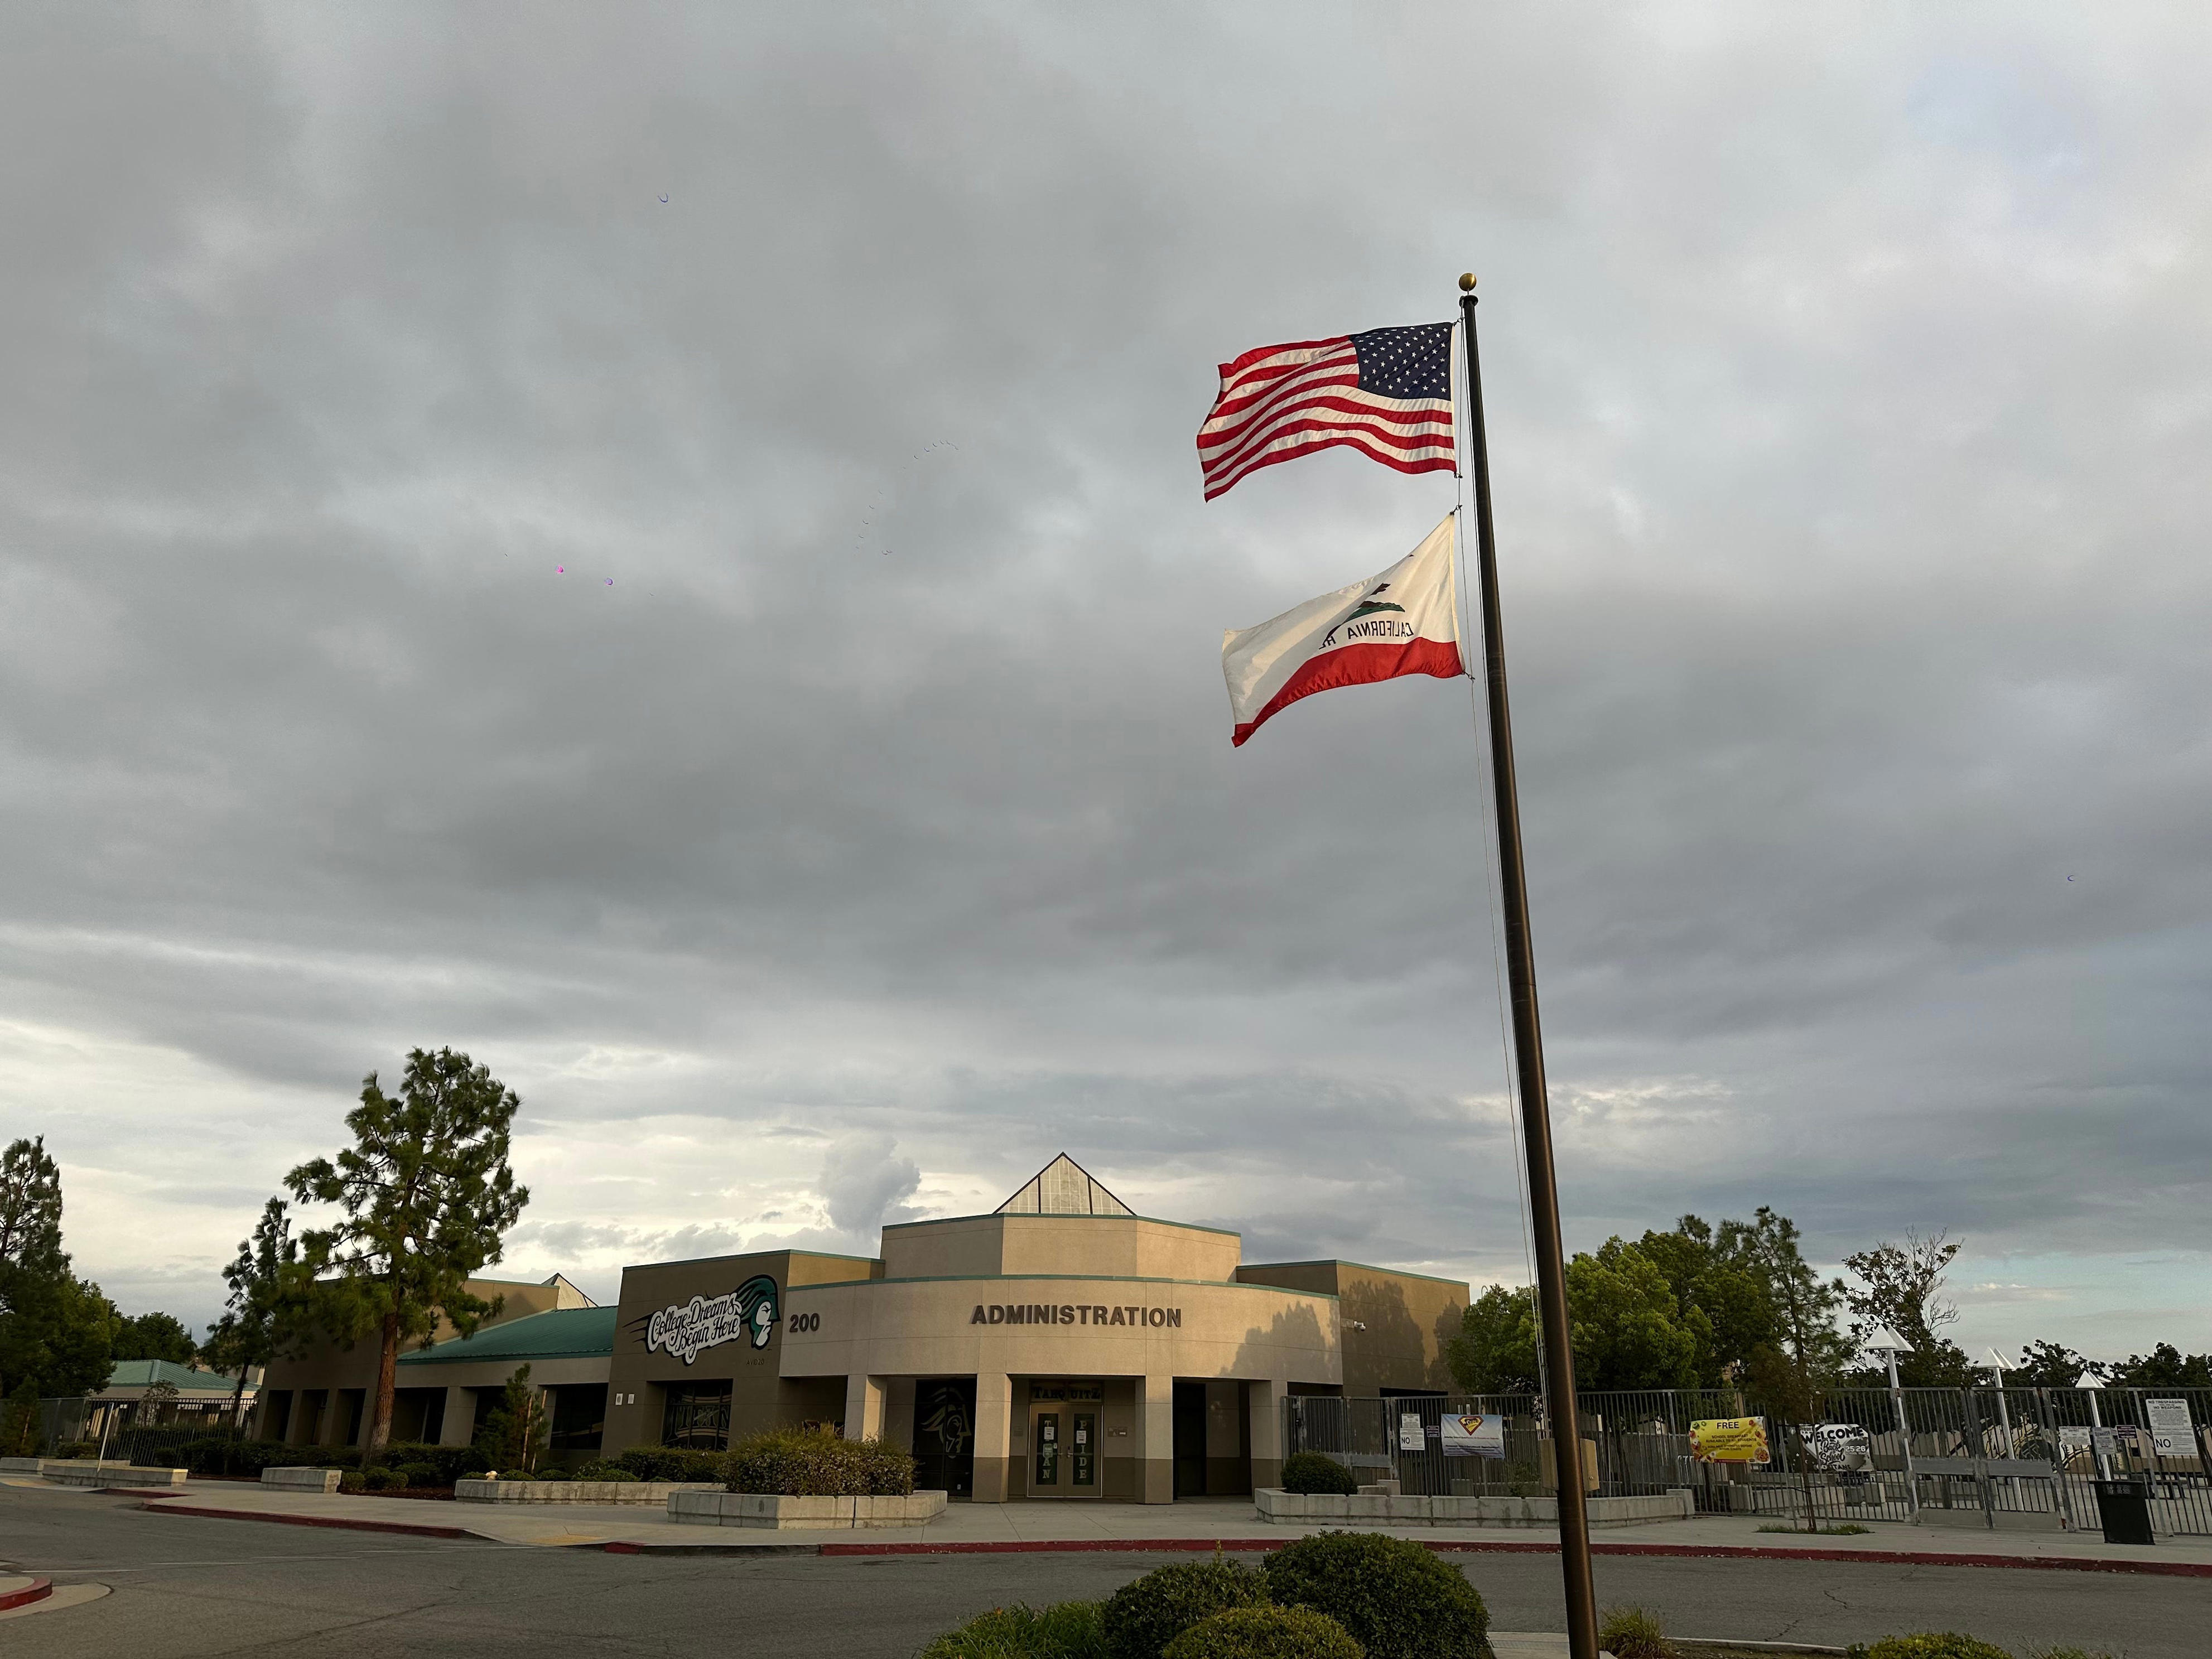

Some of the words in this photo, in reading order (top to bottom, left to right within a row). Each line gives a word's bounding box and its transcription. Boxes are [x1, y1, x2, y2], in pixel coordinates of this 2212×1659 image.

[651, 1310, 688, 1346] College
[687, 1298, 740, 1326] Dreams
[789, 1313, 820, 1333] 200
[970, 1304, 1182, 1327] ADMINISTRATION
[675, 1324, 709, 1359] Begin
[711, 1316, 739, 1340] Here
[1042, 1420, 1052, 1479] TAN
[1079, 1420, 1087, 1479] PIDE
[1801, 1426, 1864, 1444] WELCOME
[2155, 1439, 2171, 1448] NO
